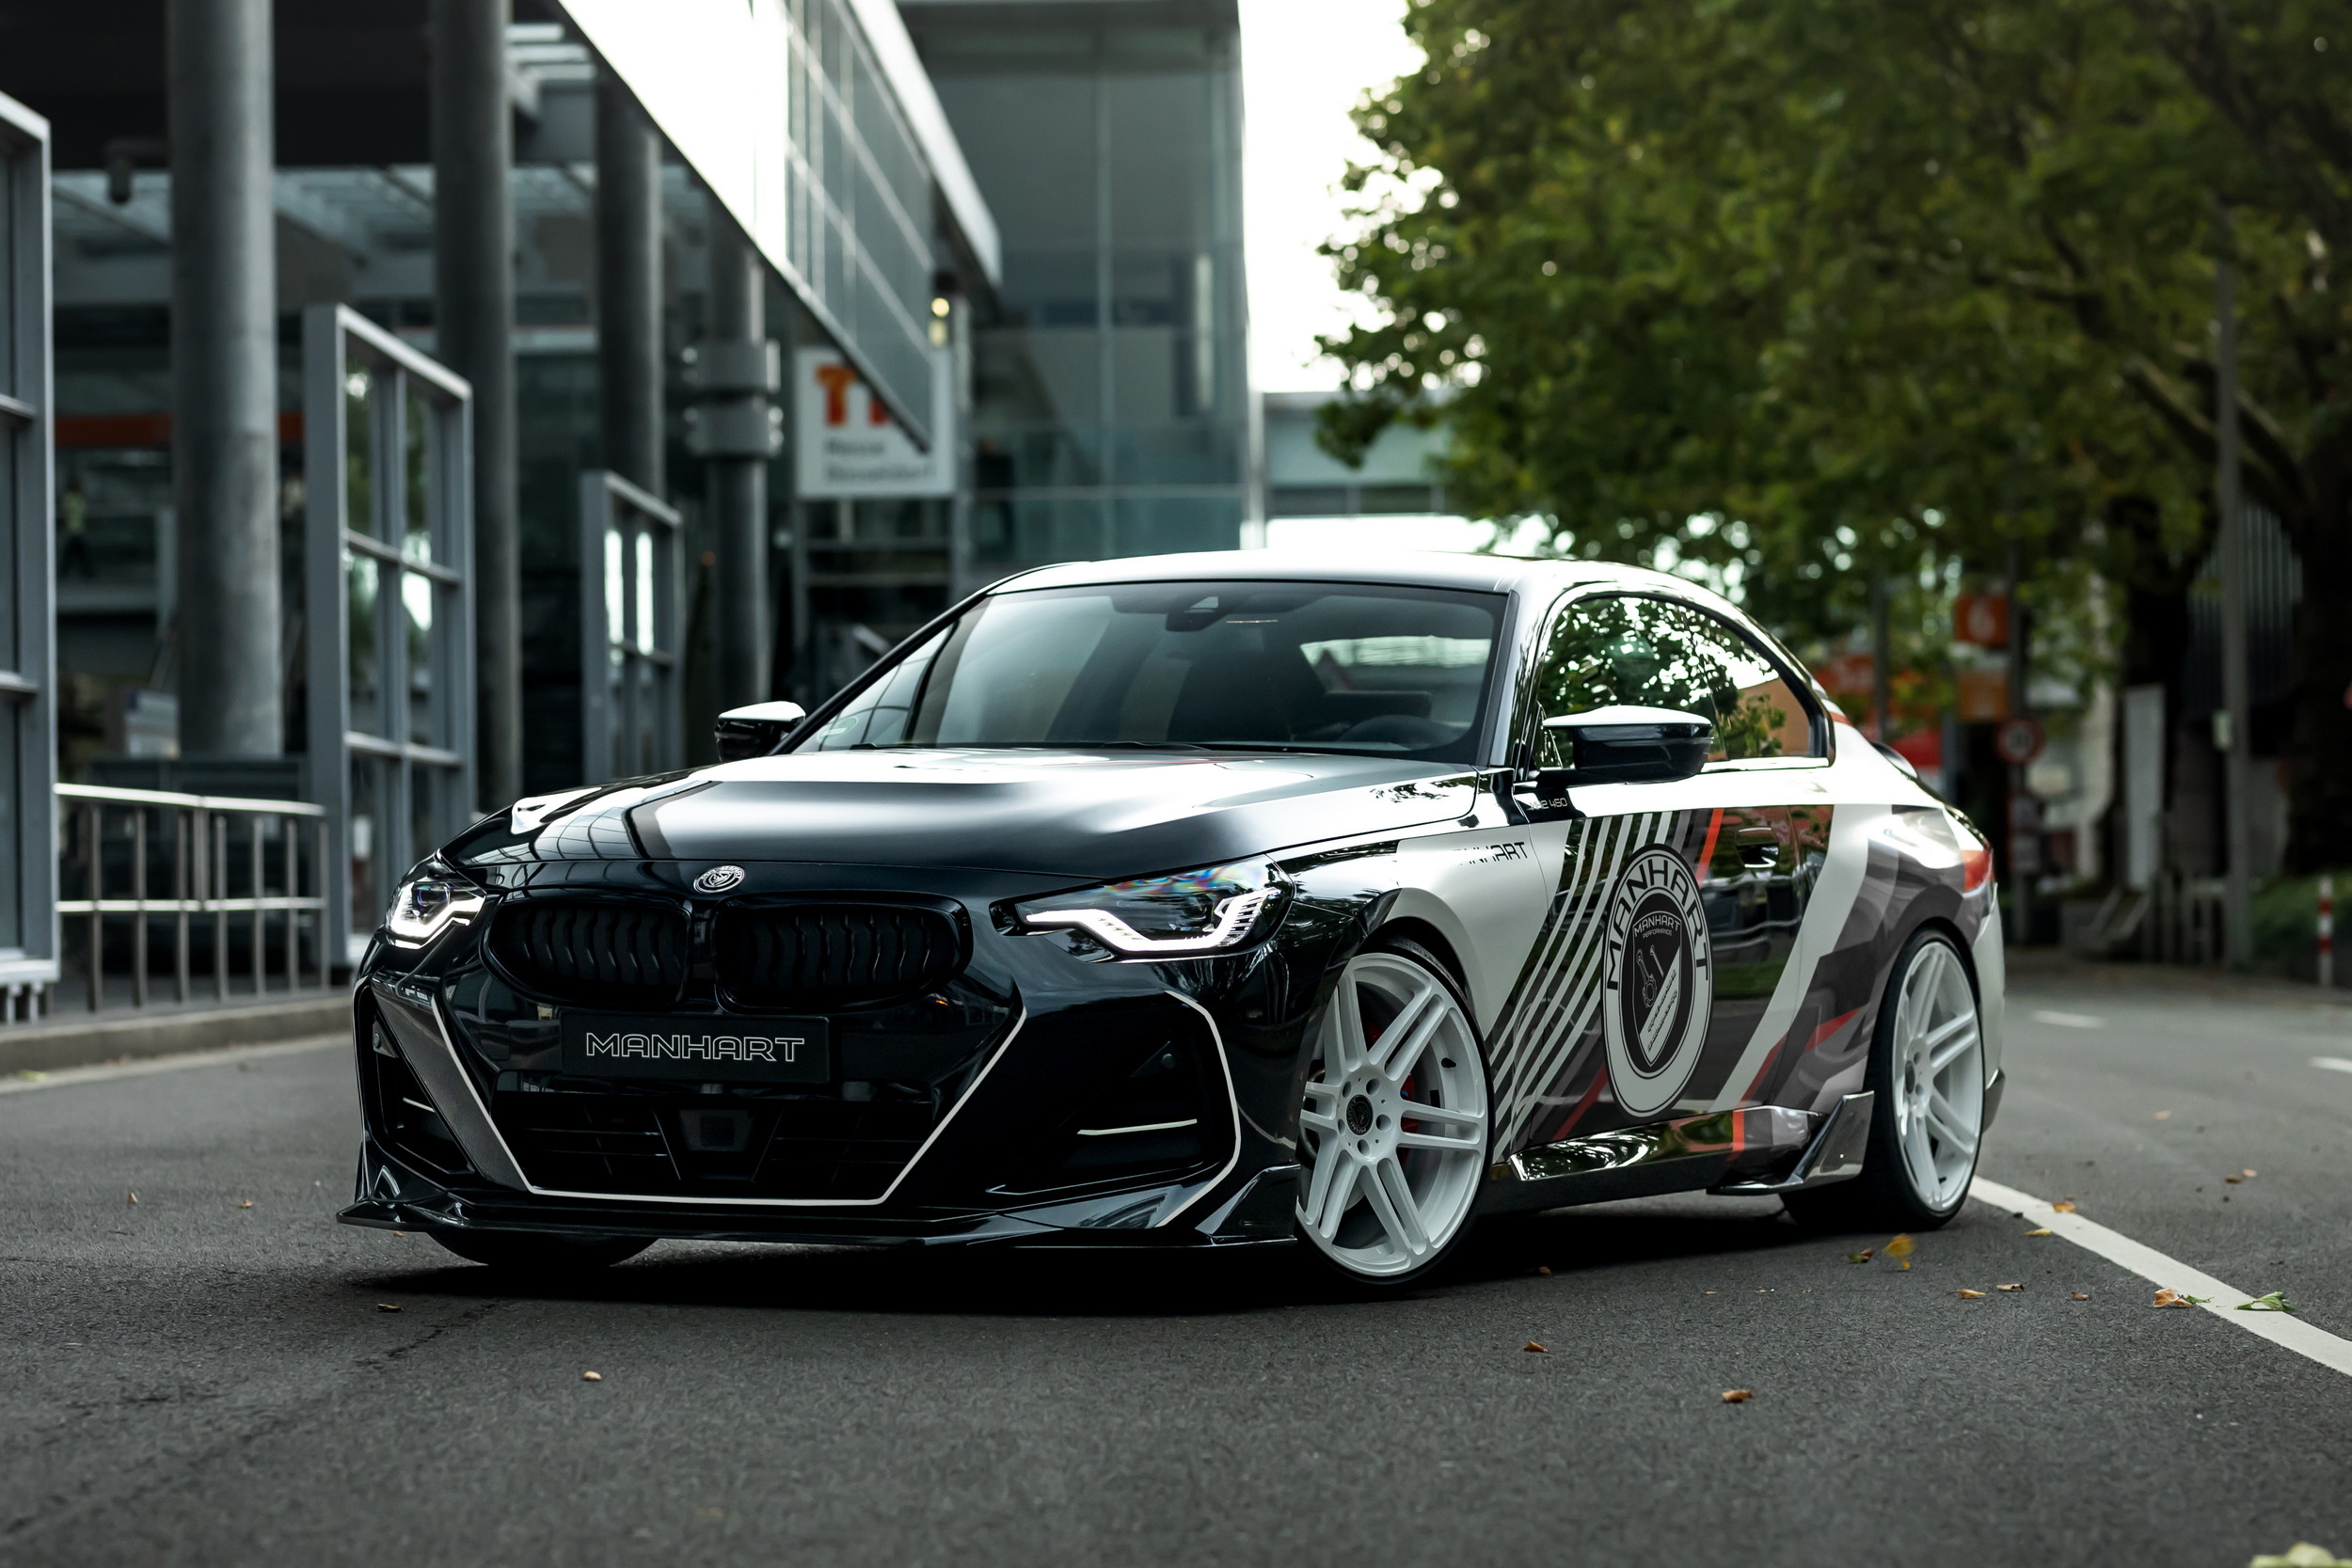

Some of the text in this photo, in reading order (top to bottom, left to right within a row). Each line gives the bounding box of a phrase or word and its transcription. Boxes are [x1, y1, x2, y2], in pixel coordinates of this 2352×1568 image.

[1549, 798, 1568, 808] 450
[1607, 859, 1708, 990] MANHART
[1633, 914, 1680, 937] MANHART
[1643, 927, 1672, 939] PERFORMANCE
[586, 1033, 804, 1062] MANHART
